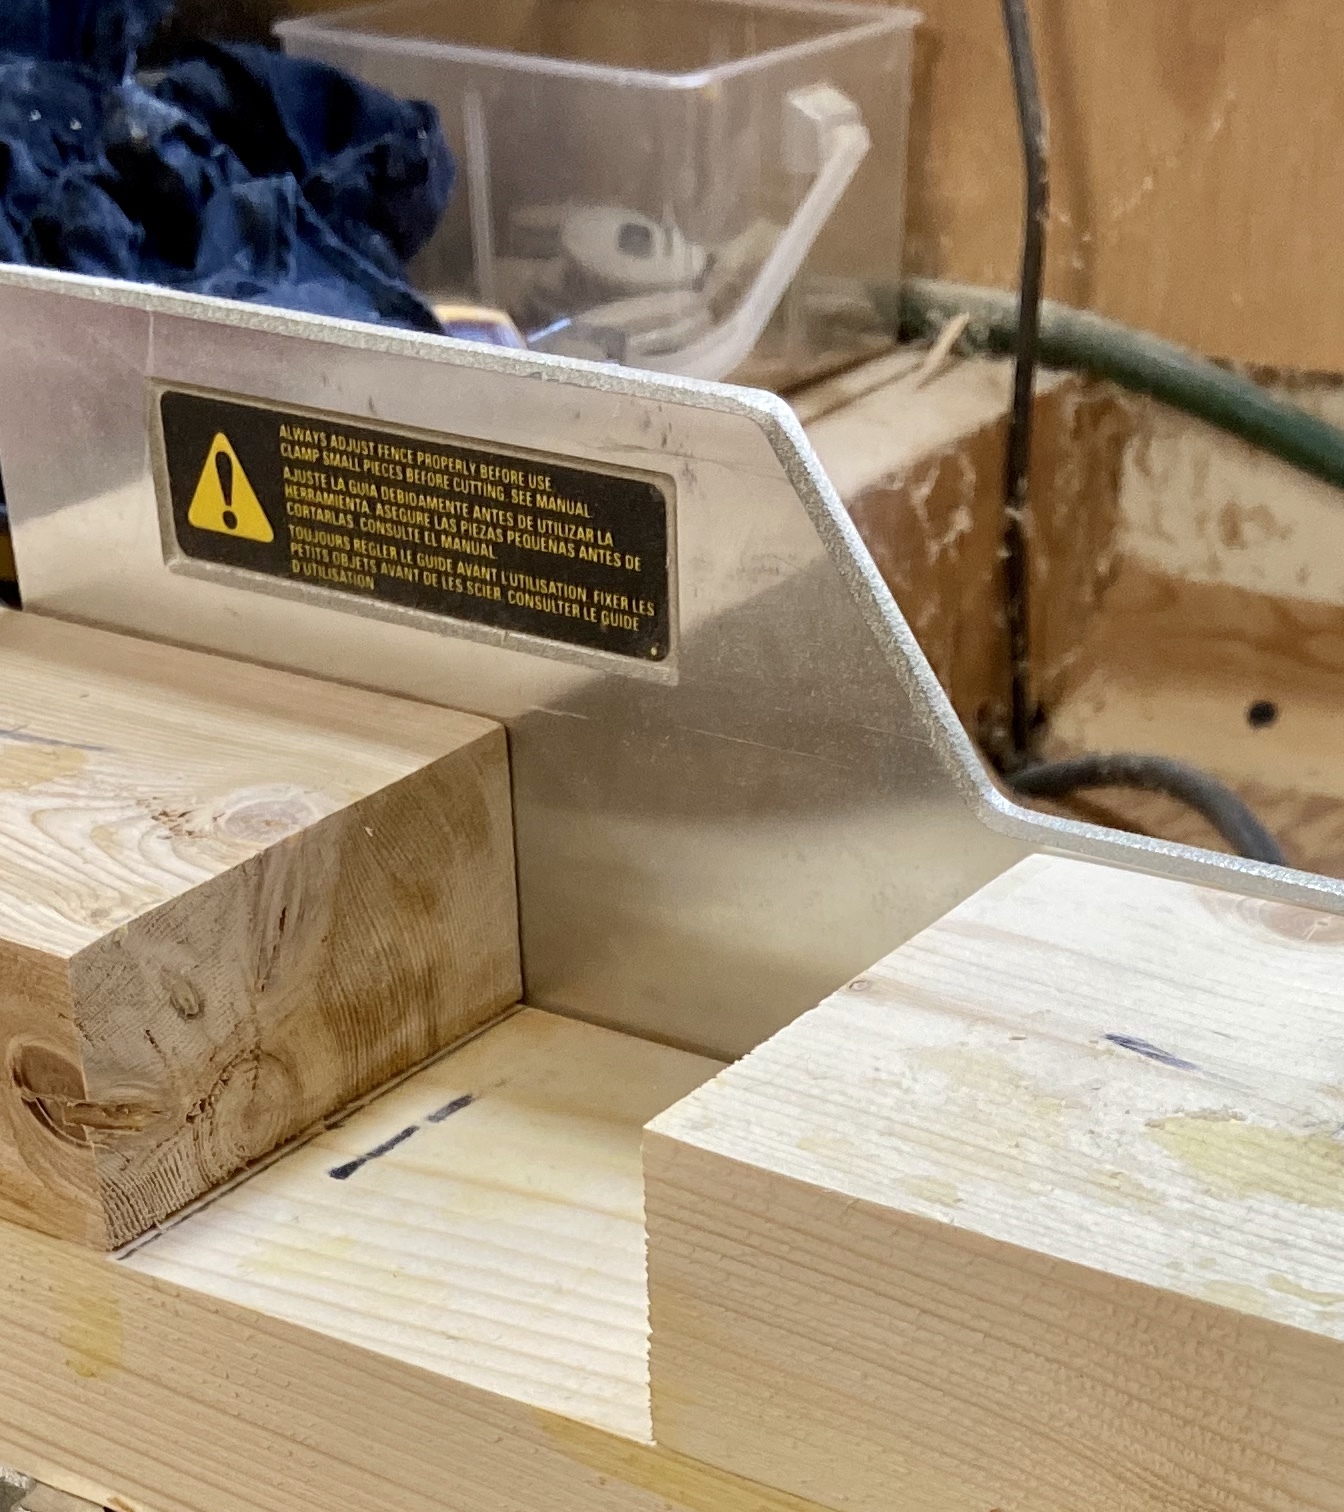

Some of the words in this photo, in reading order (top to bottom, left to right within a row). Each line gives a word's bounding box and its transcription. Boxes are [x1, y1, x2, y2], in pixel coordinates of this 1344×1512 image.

[279, 424, 327, 447] ALWAYS
[330, 434, 375, 456] ADJUST
[378, 444, 414, 464] FENCE
[417, 451, 476, 477] PROPERLY
[480, 464, 525, 487] BEFORE
[281, 443, 320, 463] CLAMP
[323, 452, 361, 472] SMALL
[363, 460, 403, 480] PIECES
[406, 467, 450, 490] BEFORE
[511, 488, 533, 507] SEE
[284, 466, 327, 488] AJUSTE
[331, 476, 346, 491] LA
[381, 486, 470, 517] DEBIDAMENTE
[473, 505, 514, 527] ANTES
[518, 514, 533, 530] DE
[537, 518, 594, 543] UTILIZAR
[597, 530, 614, 547] LA
[360, 518, 420, 543] CONSULTE
[376, 503, 430, 529] ASEGURE
[434, 515, 457, 533] LAS
[460, 520, 504, 543] PIEZAS
[579, 545, 622, 568] ANTES
[625, 554, 642, 572] DE
[288, 524, 351, 551] TOUJOURS
[400, 549, 413, 565] LE
[417, 552, 452, 573] GUIDE
[457, 561, 497, 582] AVANT
[594, 589, 629, 611] FIXER
[632, 598, 655, 617] LES
[291, 542, 329, 563] PETITS
[333, 551, 377, 574] OBJETS
[381, 562, 418, 584] AVANT
[423, 571, 438, 588] DE
[441, 575, 463, 593] LES
[508, 590, 580, 619] CONSULTER
[583, 606, 598, 623] LE
[601, 609, 639, 632] GUIDE
